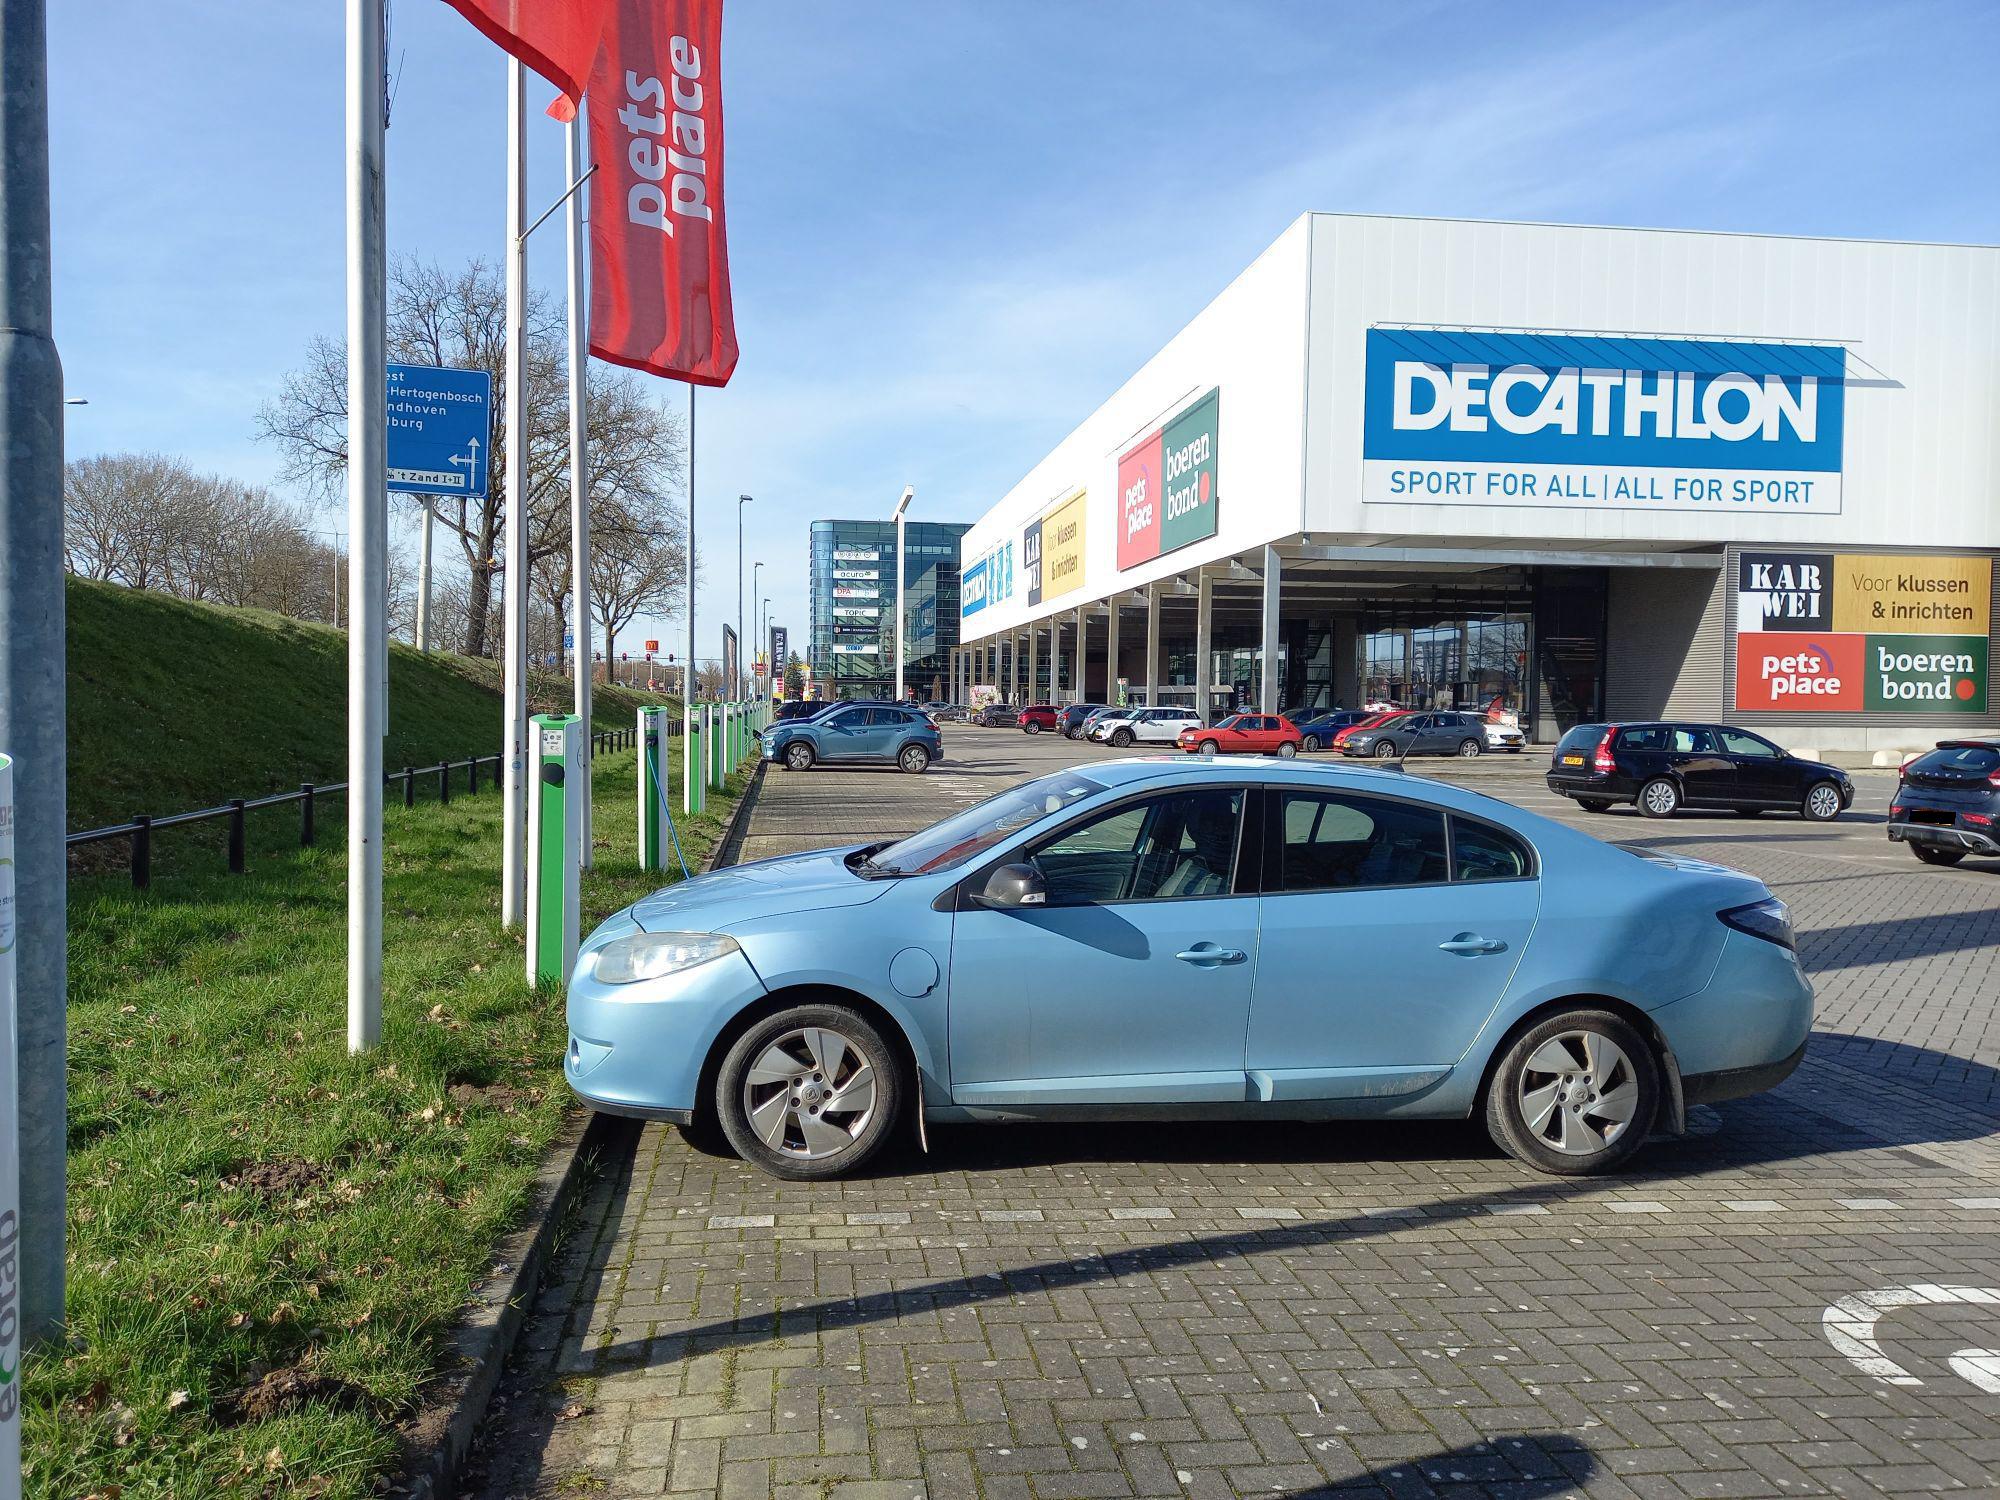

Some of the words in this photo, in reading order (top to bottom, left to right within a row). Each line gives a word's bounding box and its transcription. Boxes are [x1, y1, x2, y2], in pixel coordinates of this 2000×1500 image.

[667, 35, 713, 224] place
[617, 69, 674, 239] pets
[1392, 361, 1817, 443] DECATHLON
[1166, 432, 1210, 482] boeren
[409, 472, 440, 483] Zand
[1390, 470, 1477, 495] SPORT
[1486, 473, 1537, 497] FOR
[1546, 475, 1596, 498] ALL
[1614, 476, 1663, 500] ALL
[1674, 478, 1724, 501] FOR
[1732, 480, 1814, 503] SPORT
[1125, 477, 1147, 519] pets
[1167, 470, 1199, 521] bond
[1057, 521, 1077, 546] klussen
[1127, 502, 1153, 544] place
[1750, 563, 1822, 591] KAR
[1852, 573, 1892, 592] Voor
[1897, 574, 1969, 593] klussen
[1762, 592, 1821, 618] WEI
[1871, 600, 1886, 619] &
[1891, 601, 1973, 620] inrichten
[1761, 652, 1821, 680] pets
[1877, 646, 1974, 674] boeren
[1770, 673, 1841, 701] place
[1880, 674, 1952, 700] bond
